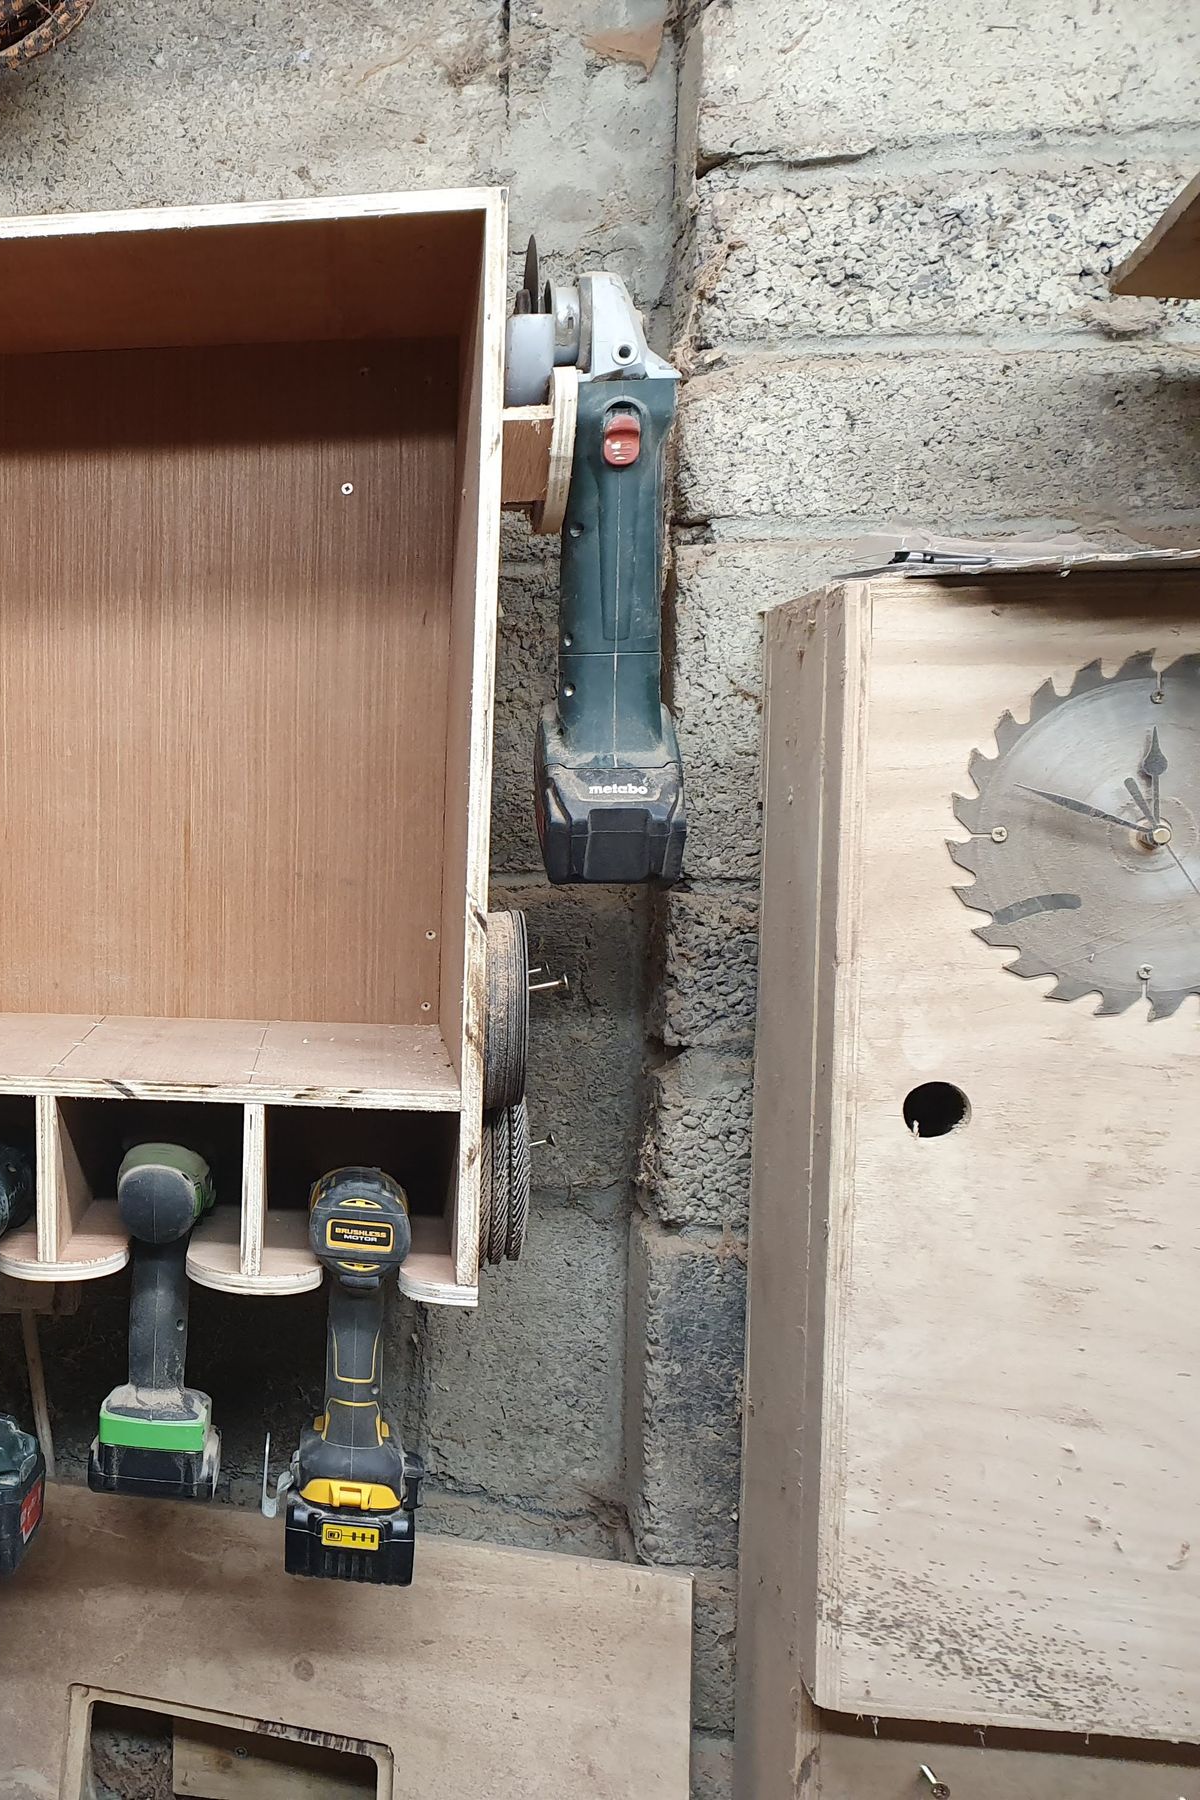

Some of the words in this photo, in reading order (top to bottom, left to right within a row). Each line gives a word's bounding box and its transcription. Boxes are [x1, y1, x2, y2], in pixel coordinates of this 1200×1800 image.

[588, 783, 649, 795] metabo
[334, 1227, 388, 1239] BRUSHLESS
[343, 1235, 378, 1243] MOTOR
